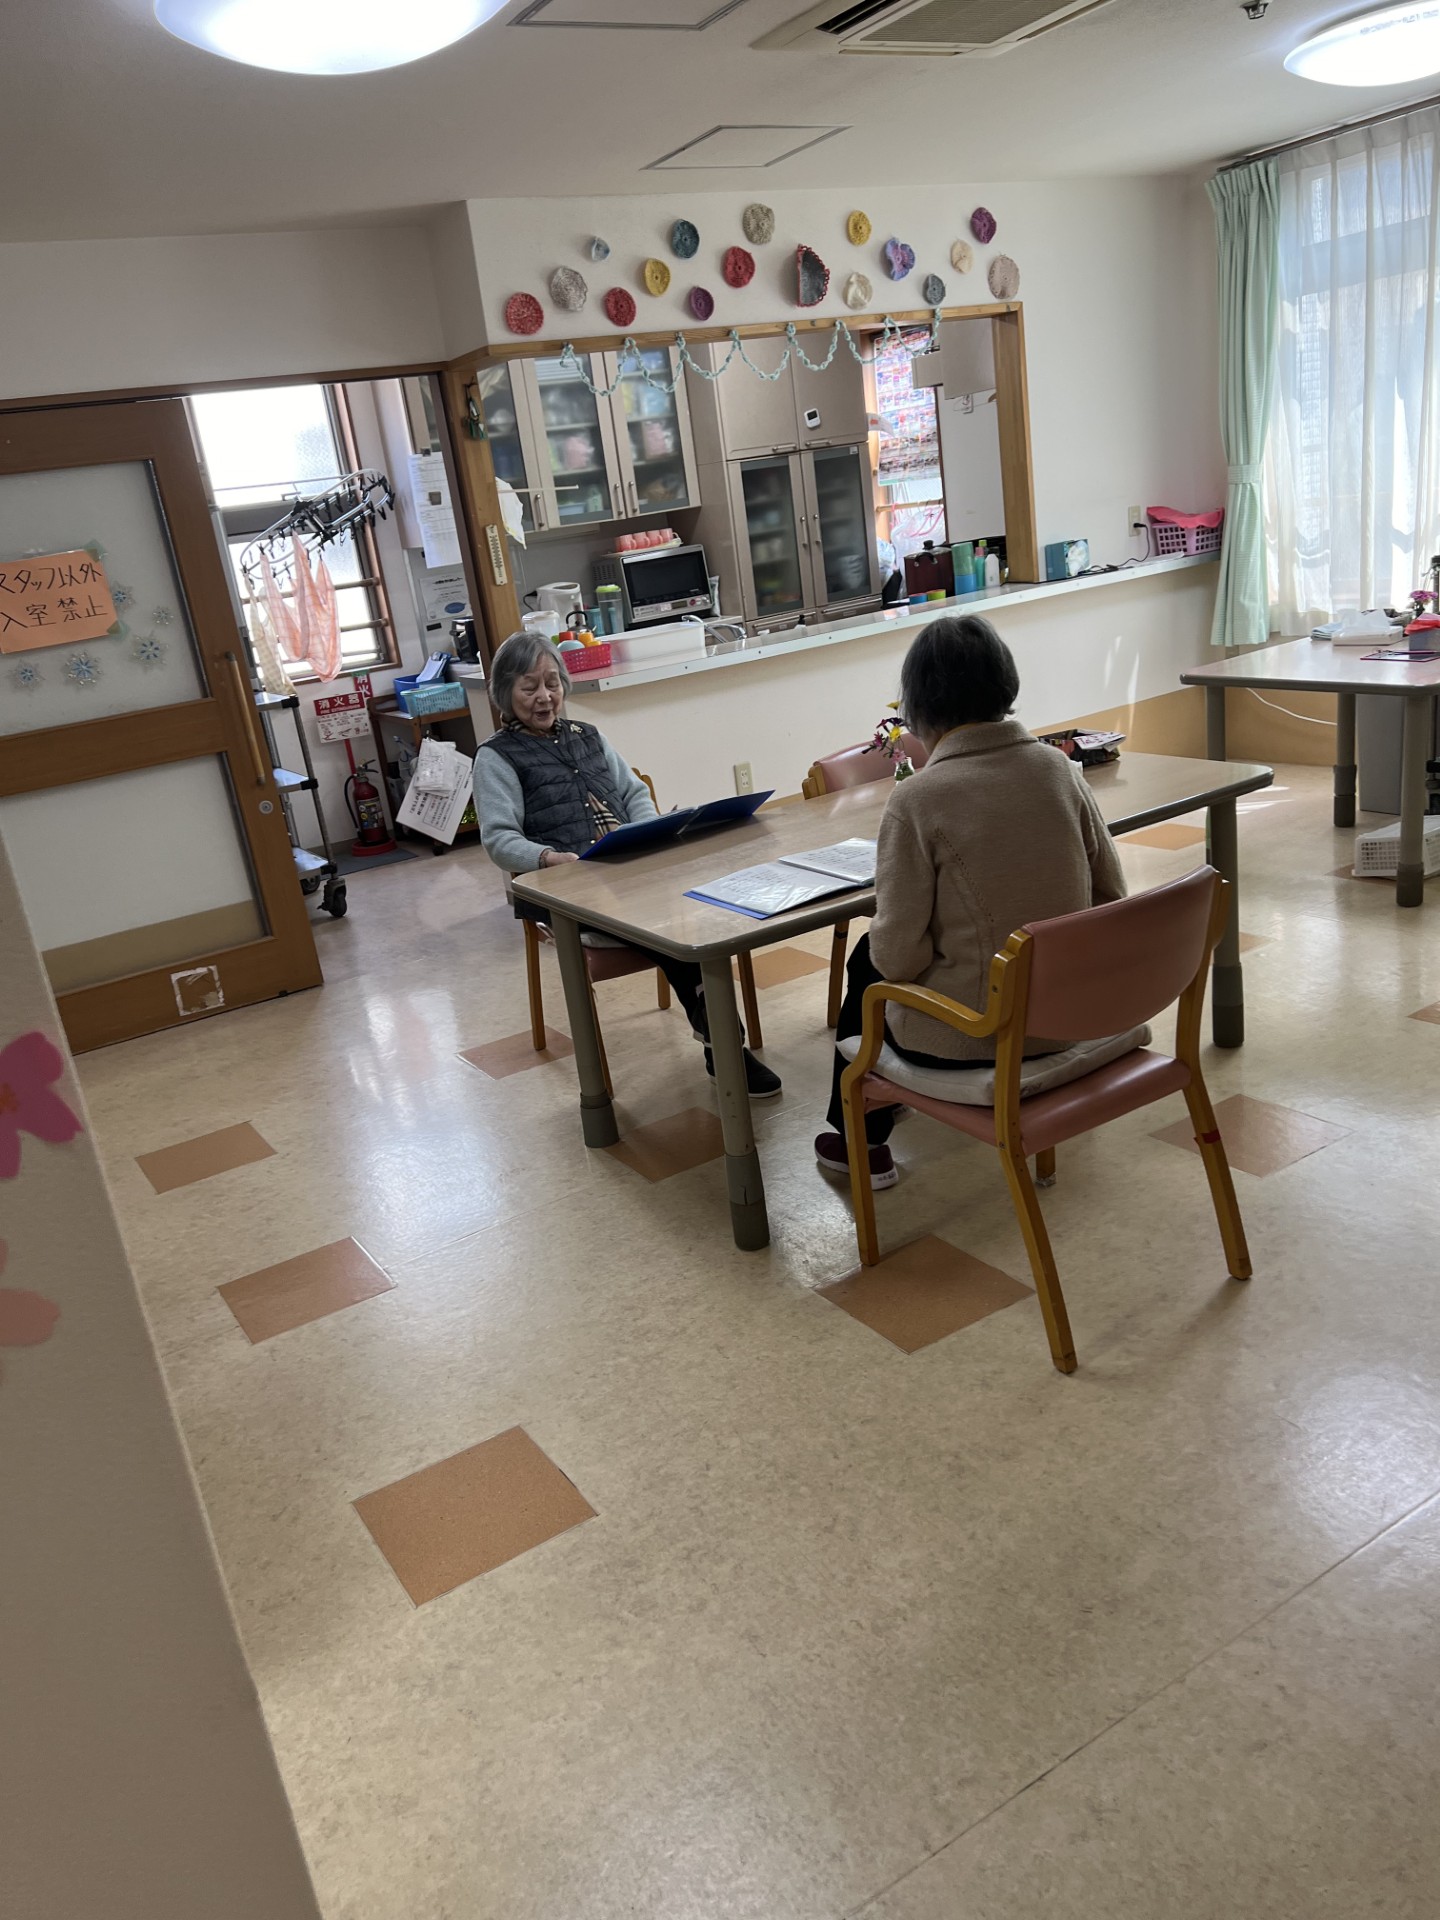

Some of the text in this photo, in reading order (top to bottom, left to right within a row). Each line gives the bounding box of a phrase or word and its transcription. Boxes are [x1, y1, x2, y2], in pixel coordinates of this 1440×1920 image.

[0, 562, 103, 594] スタッフ以外
[0, 595, 108, 632] 入室禁止
[318, 693, 360, 710] 消火器
